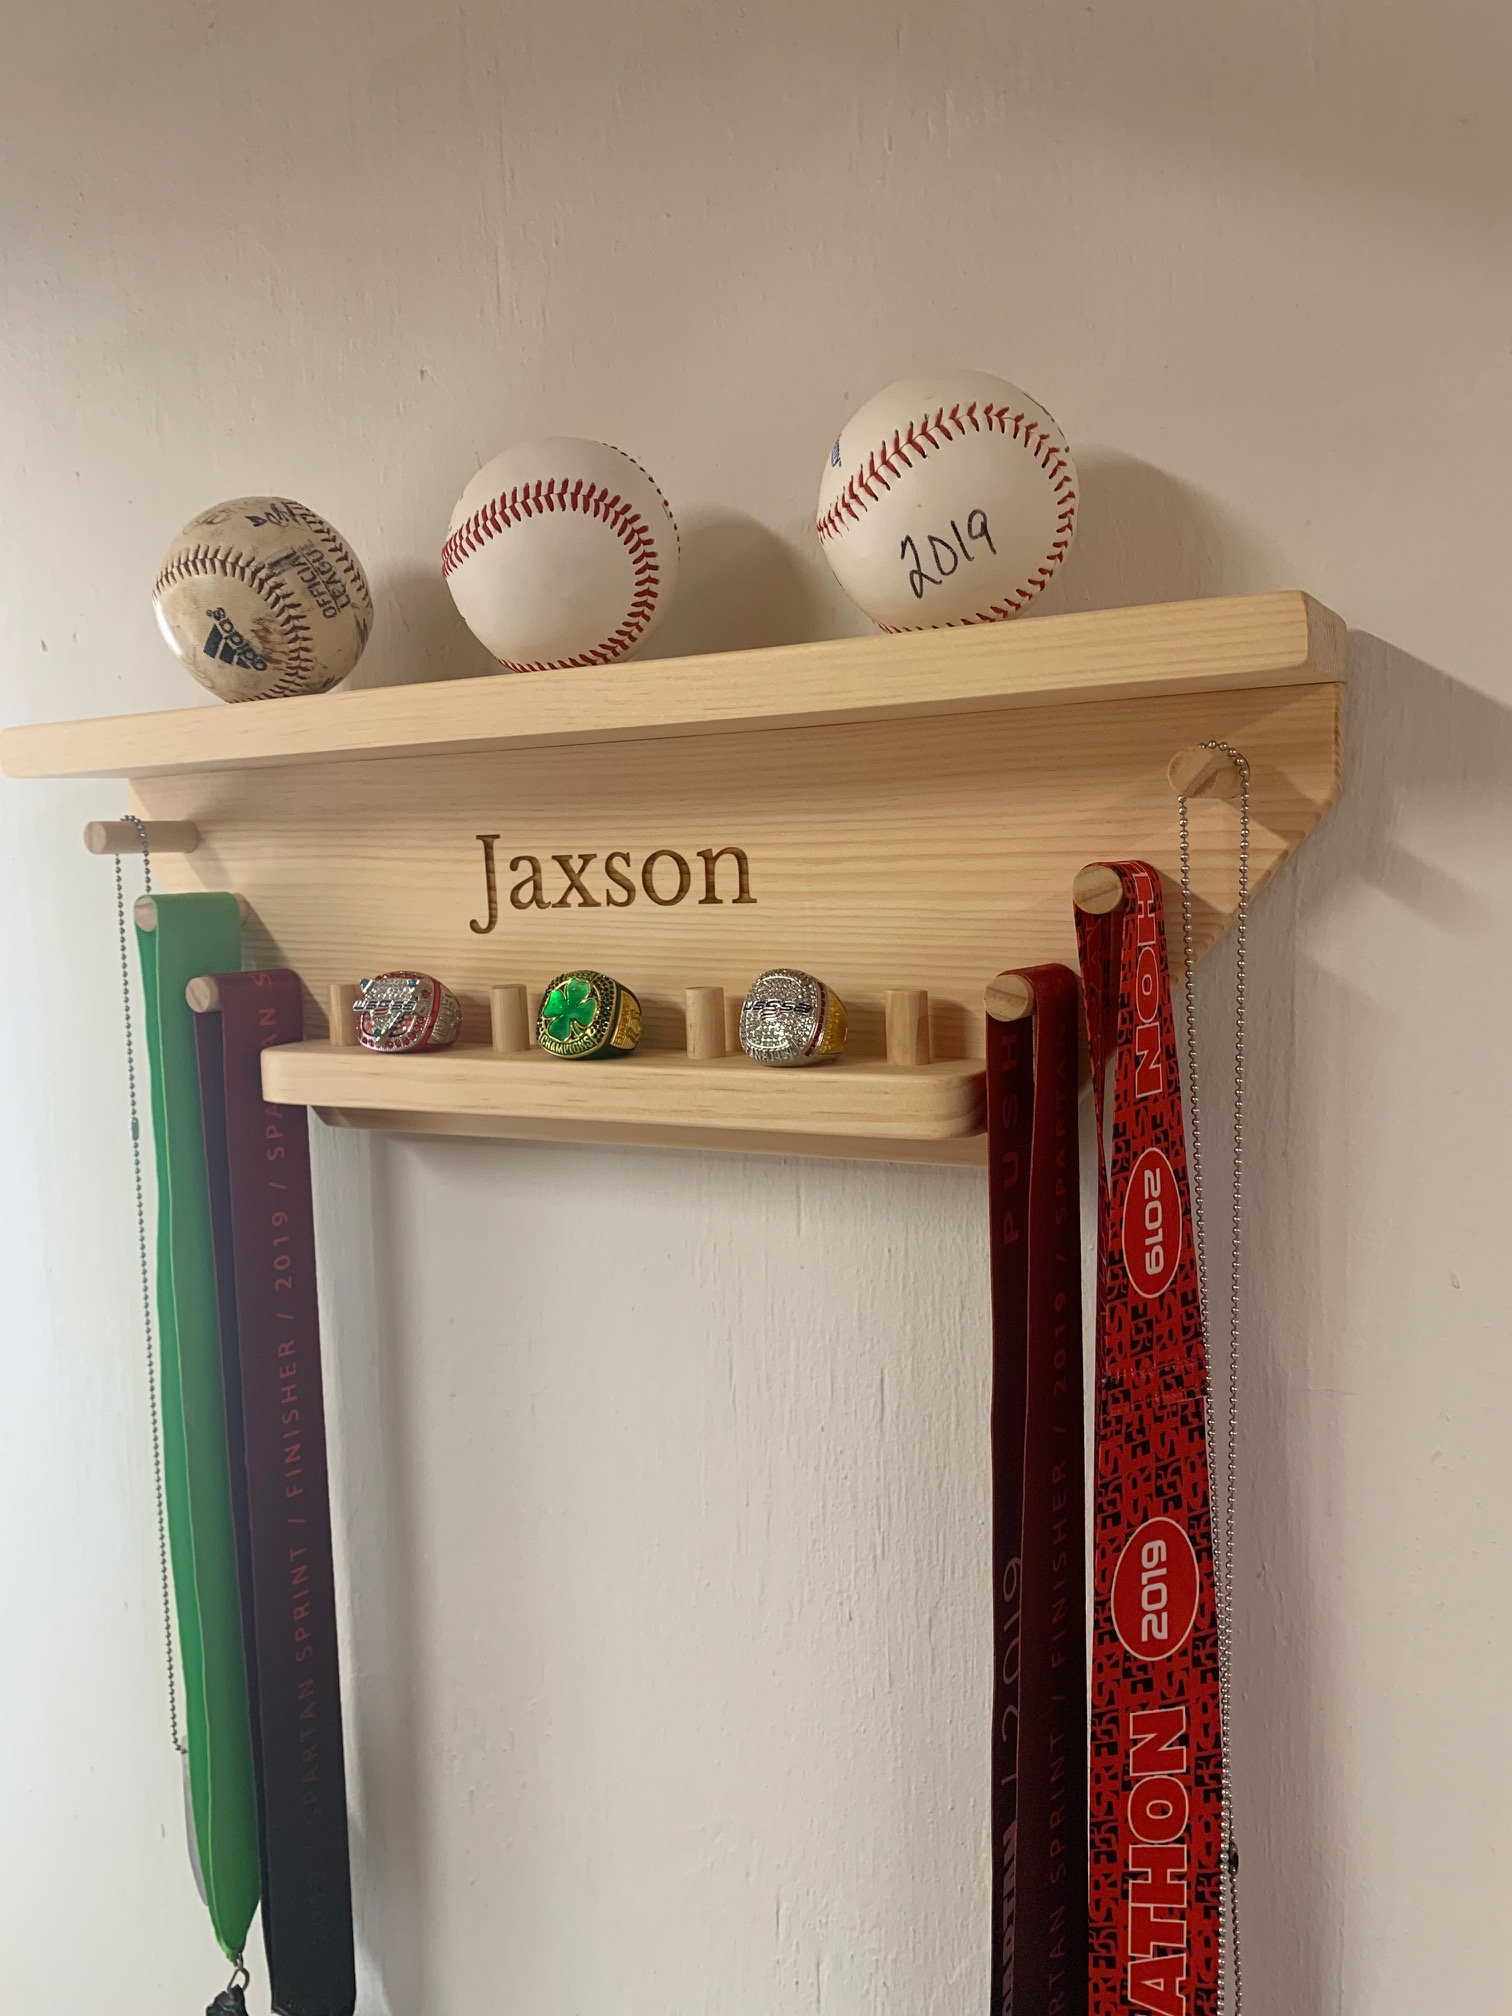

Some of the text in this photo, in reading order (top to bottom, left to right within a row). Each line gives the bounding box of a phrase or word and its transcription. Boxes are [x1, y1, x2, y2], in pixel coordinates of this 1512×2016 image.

[900, 509, 996, 599] 2019
[205, 607, 268, 672] adidas
[469, 834, 758, 934] Jaxson
[541, 1034, 594, 1054] CHAMPIONS
[998, 1032, 1020, 1247] PUSH
[270, 1211, 293, 1291] 2019
[1143, 1167, 1165, 1276] 2019
[1053, 1290, 1068, 1398] 2019
[277, 1340, 303, 1498] FINISHER
[288, 1546, 314, 1662] SPRINT
[1051, 1460, 1068, 1669] FINISHER
[1141, 1540, 1169, 1642] 2019
[1049, 1731, 1067, 1885] SPRINT
